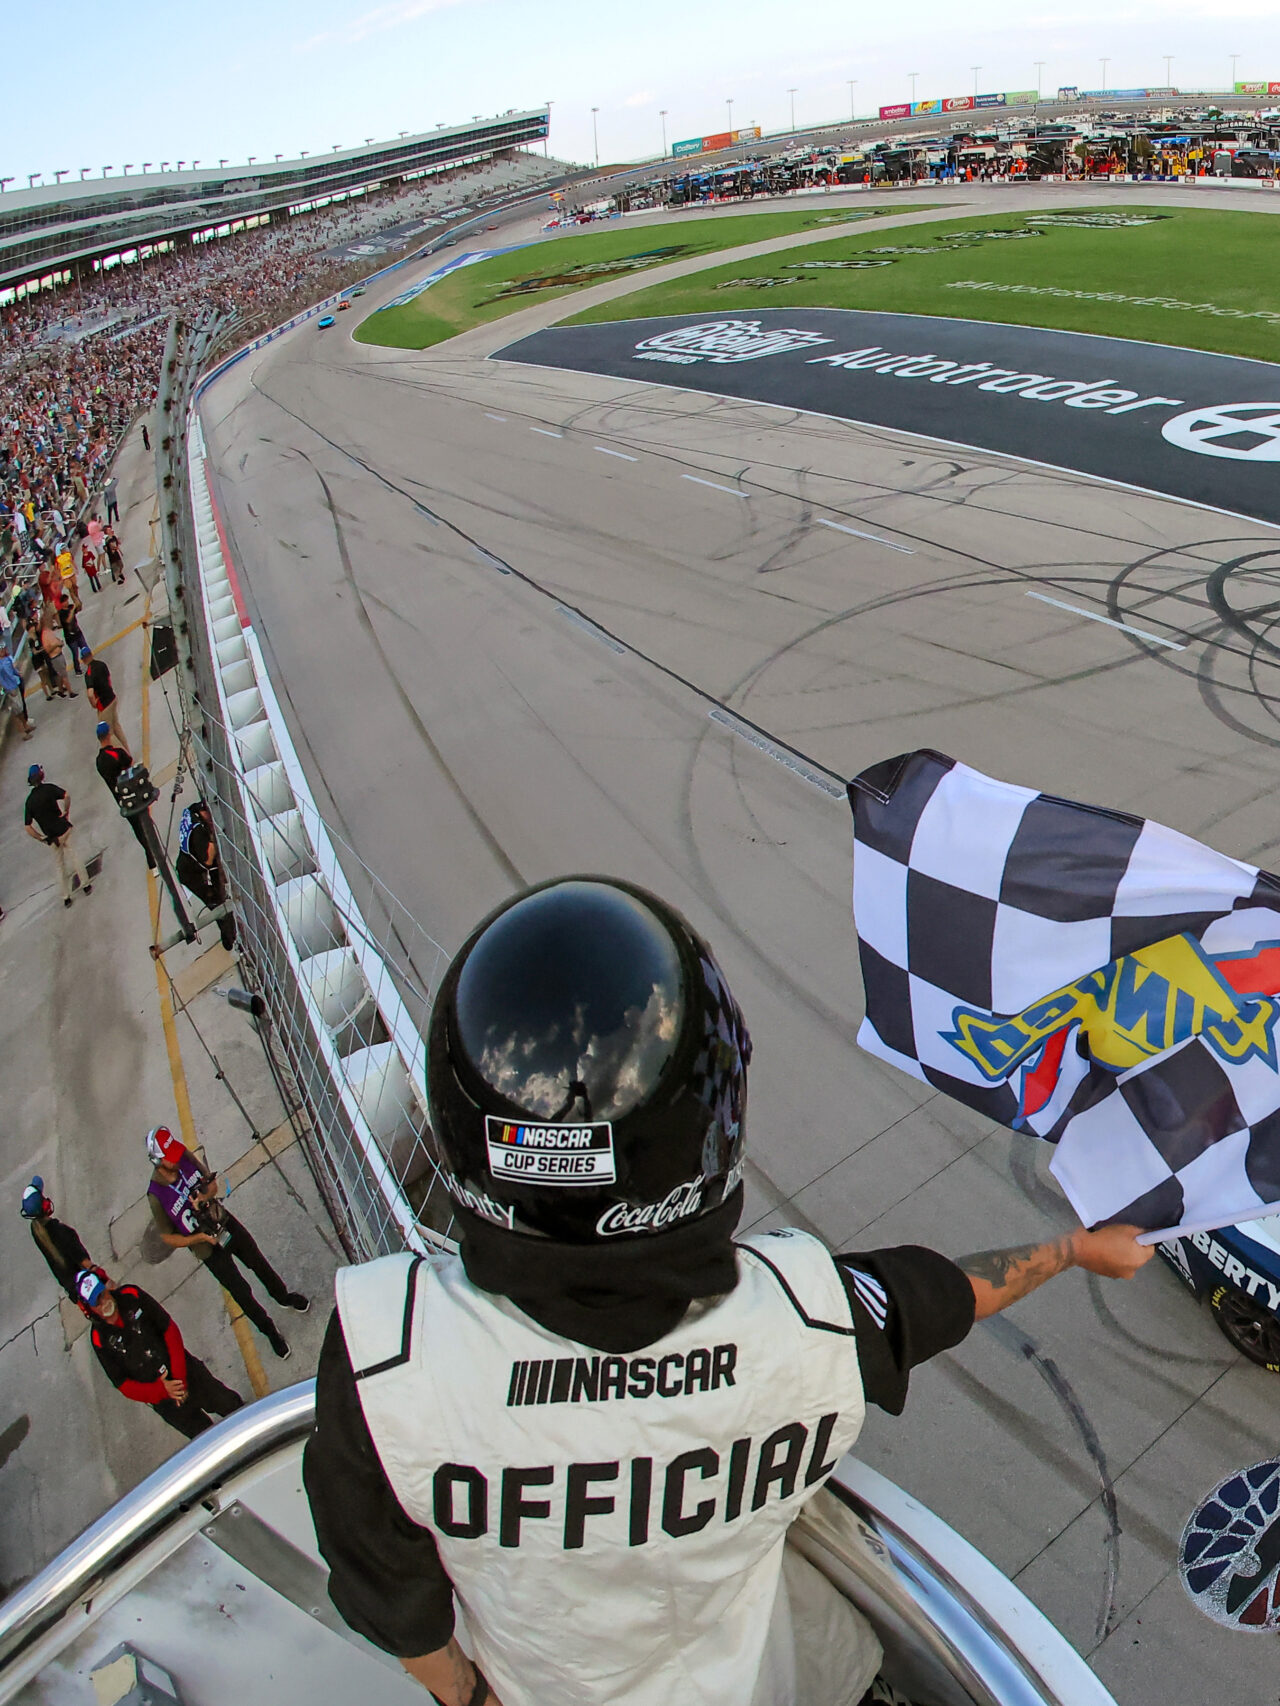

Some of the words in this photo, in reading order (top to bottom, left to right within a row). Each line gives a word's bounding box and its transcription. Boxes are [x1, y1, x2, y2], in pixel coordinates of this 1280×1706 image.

[805, 346, 1185, 415] Autotrader
[504, 1153, 536, 1171] CUP
[537, 1155, 597, 1174] SERIES
[522, 1127, 593, 1148] NASCAR
[596, 1173, 706, 1237] Coca-Cola
[571, 1342, 739, 1403] NASCAR
[431, 1411, 840, 1551] OFFICIAL
